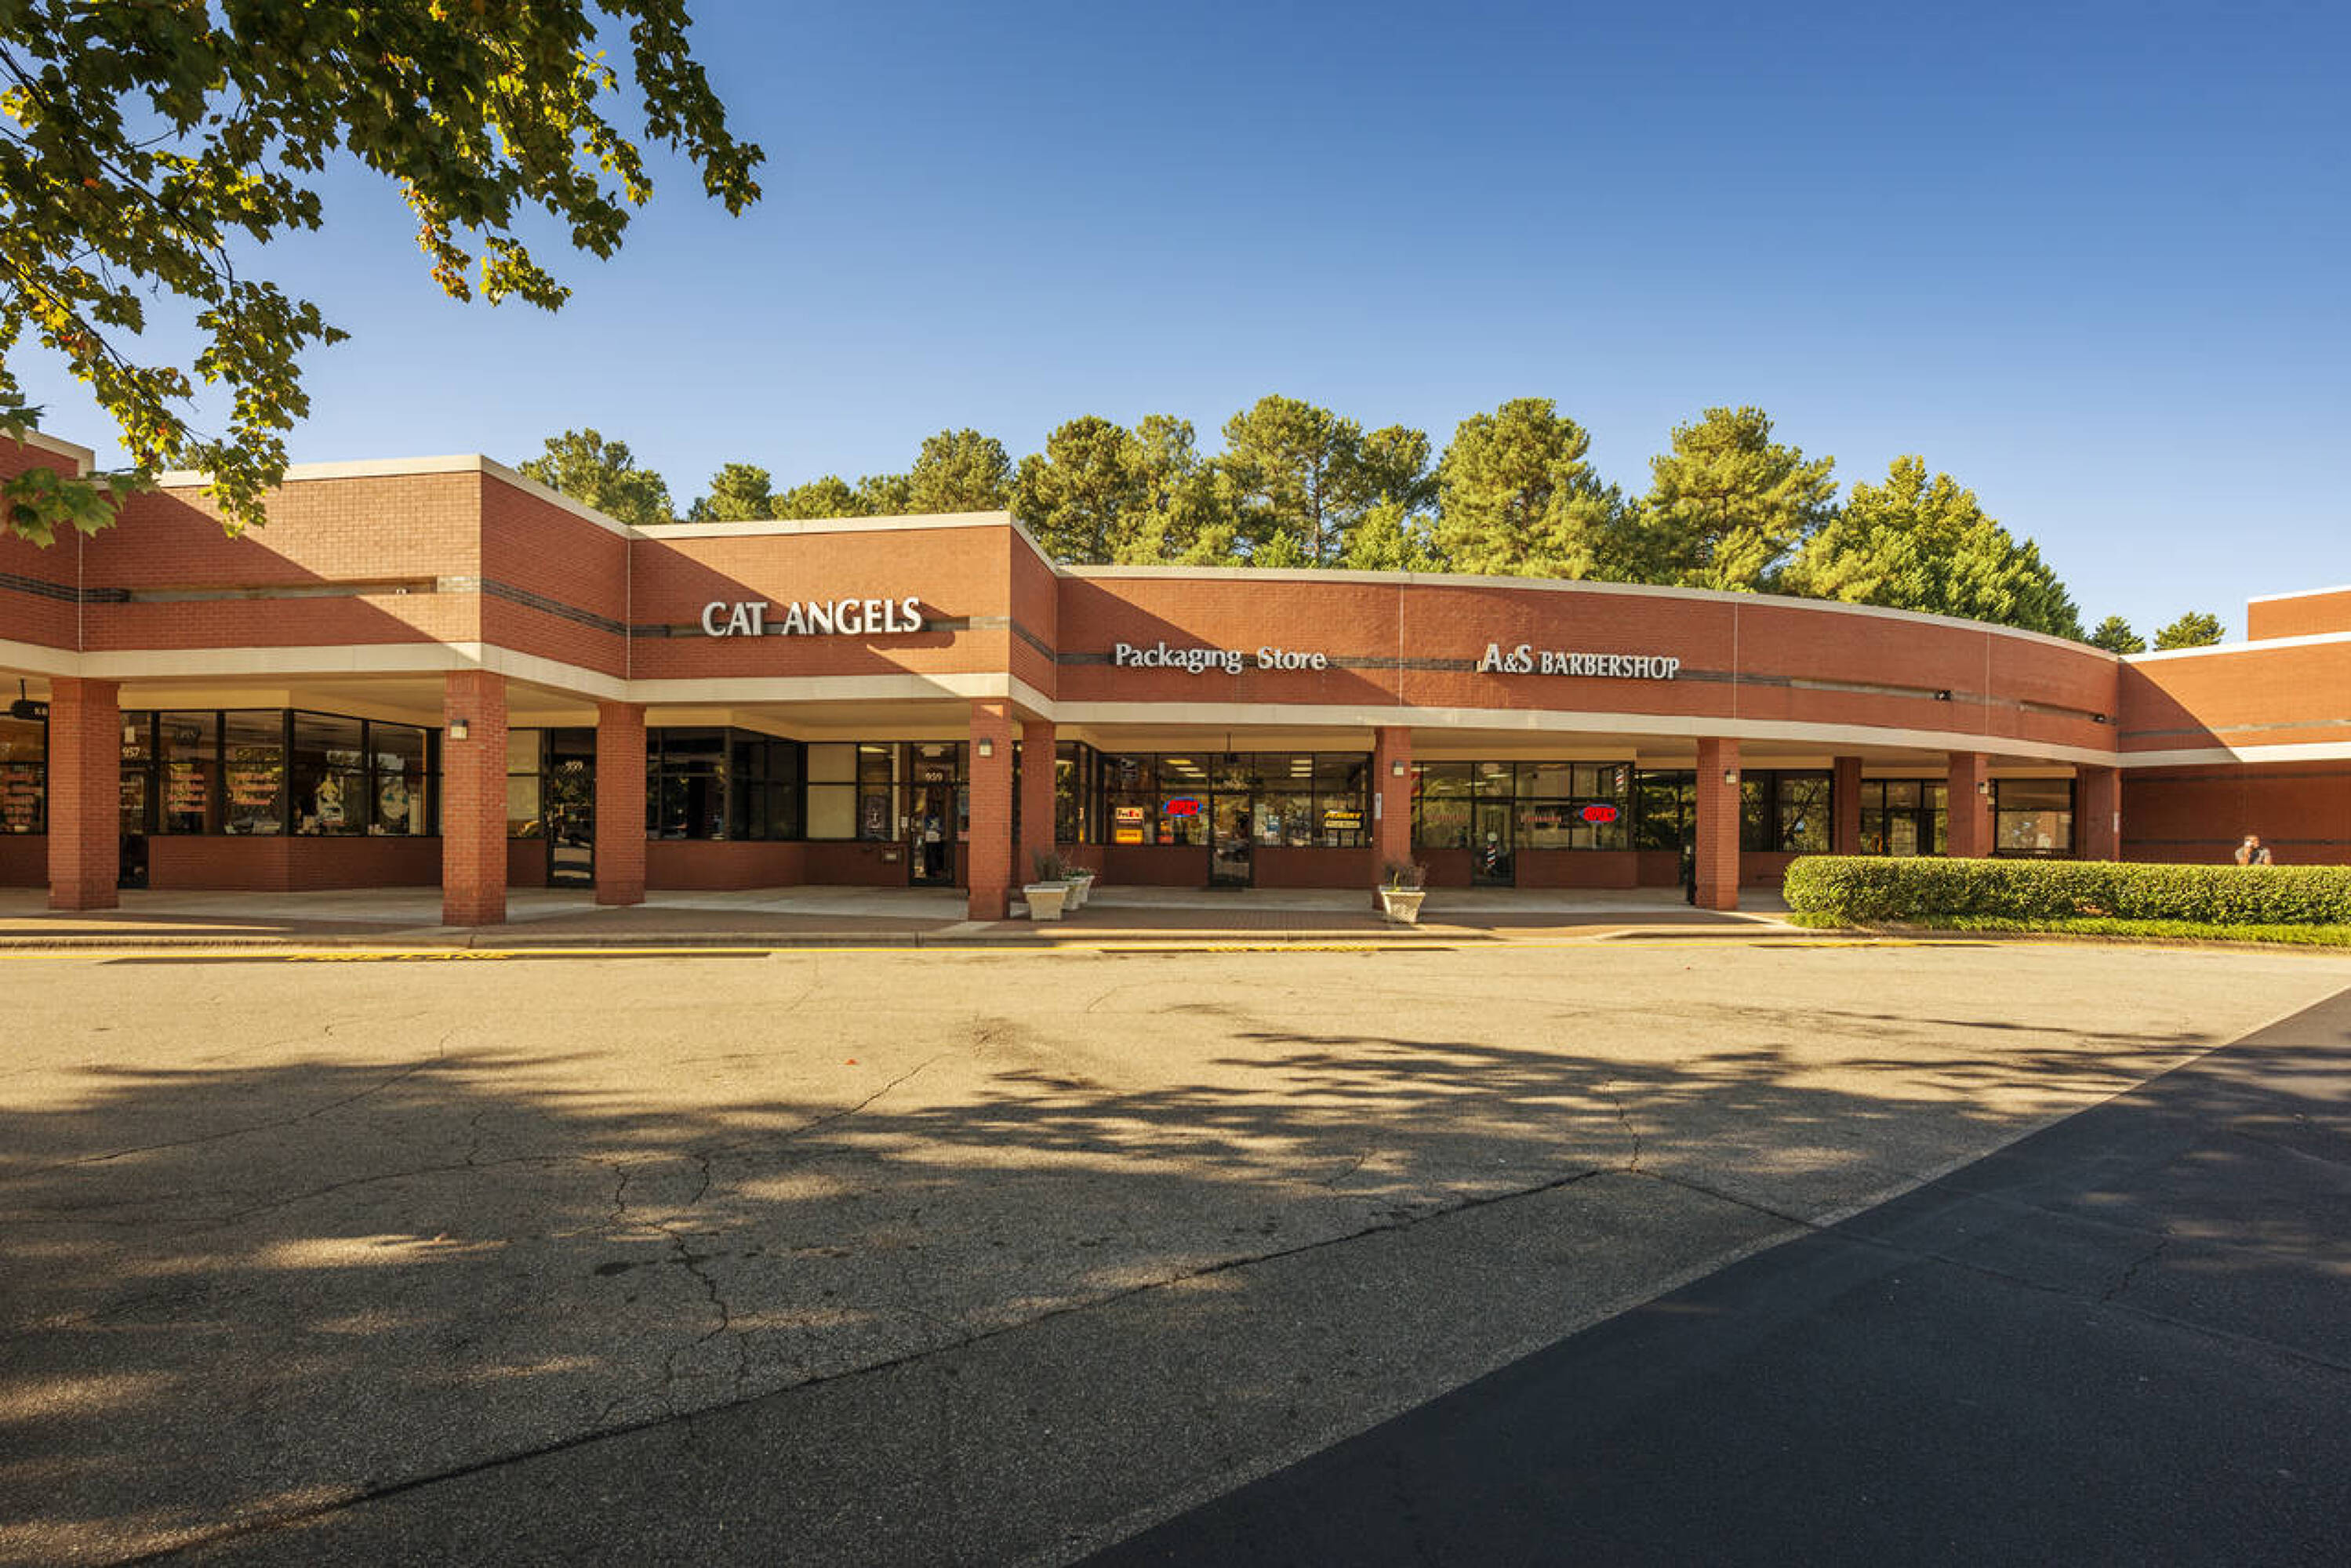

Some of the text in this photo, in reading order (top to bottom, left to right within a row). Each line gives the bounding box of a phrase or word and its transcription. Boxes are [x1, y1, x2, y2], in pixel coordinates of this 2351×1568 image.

[702, 597, 922, 636] CAT ANGELS
[1115, 641, 1327, 674] Packaging Store
[1477, 643, 1680, 680] A&S BARBERSHOP
